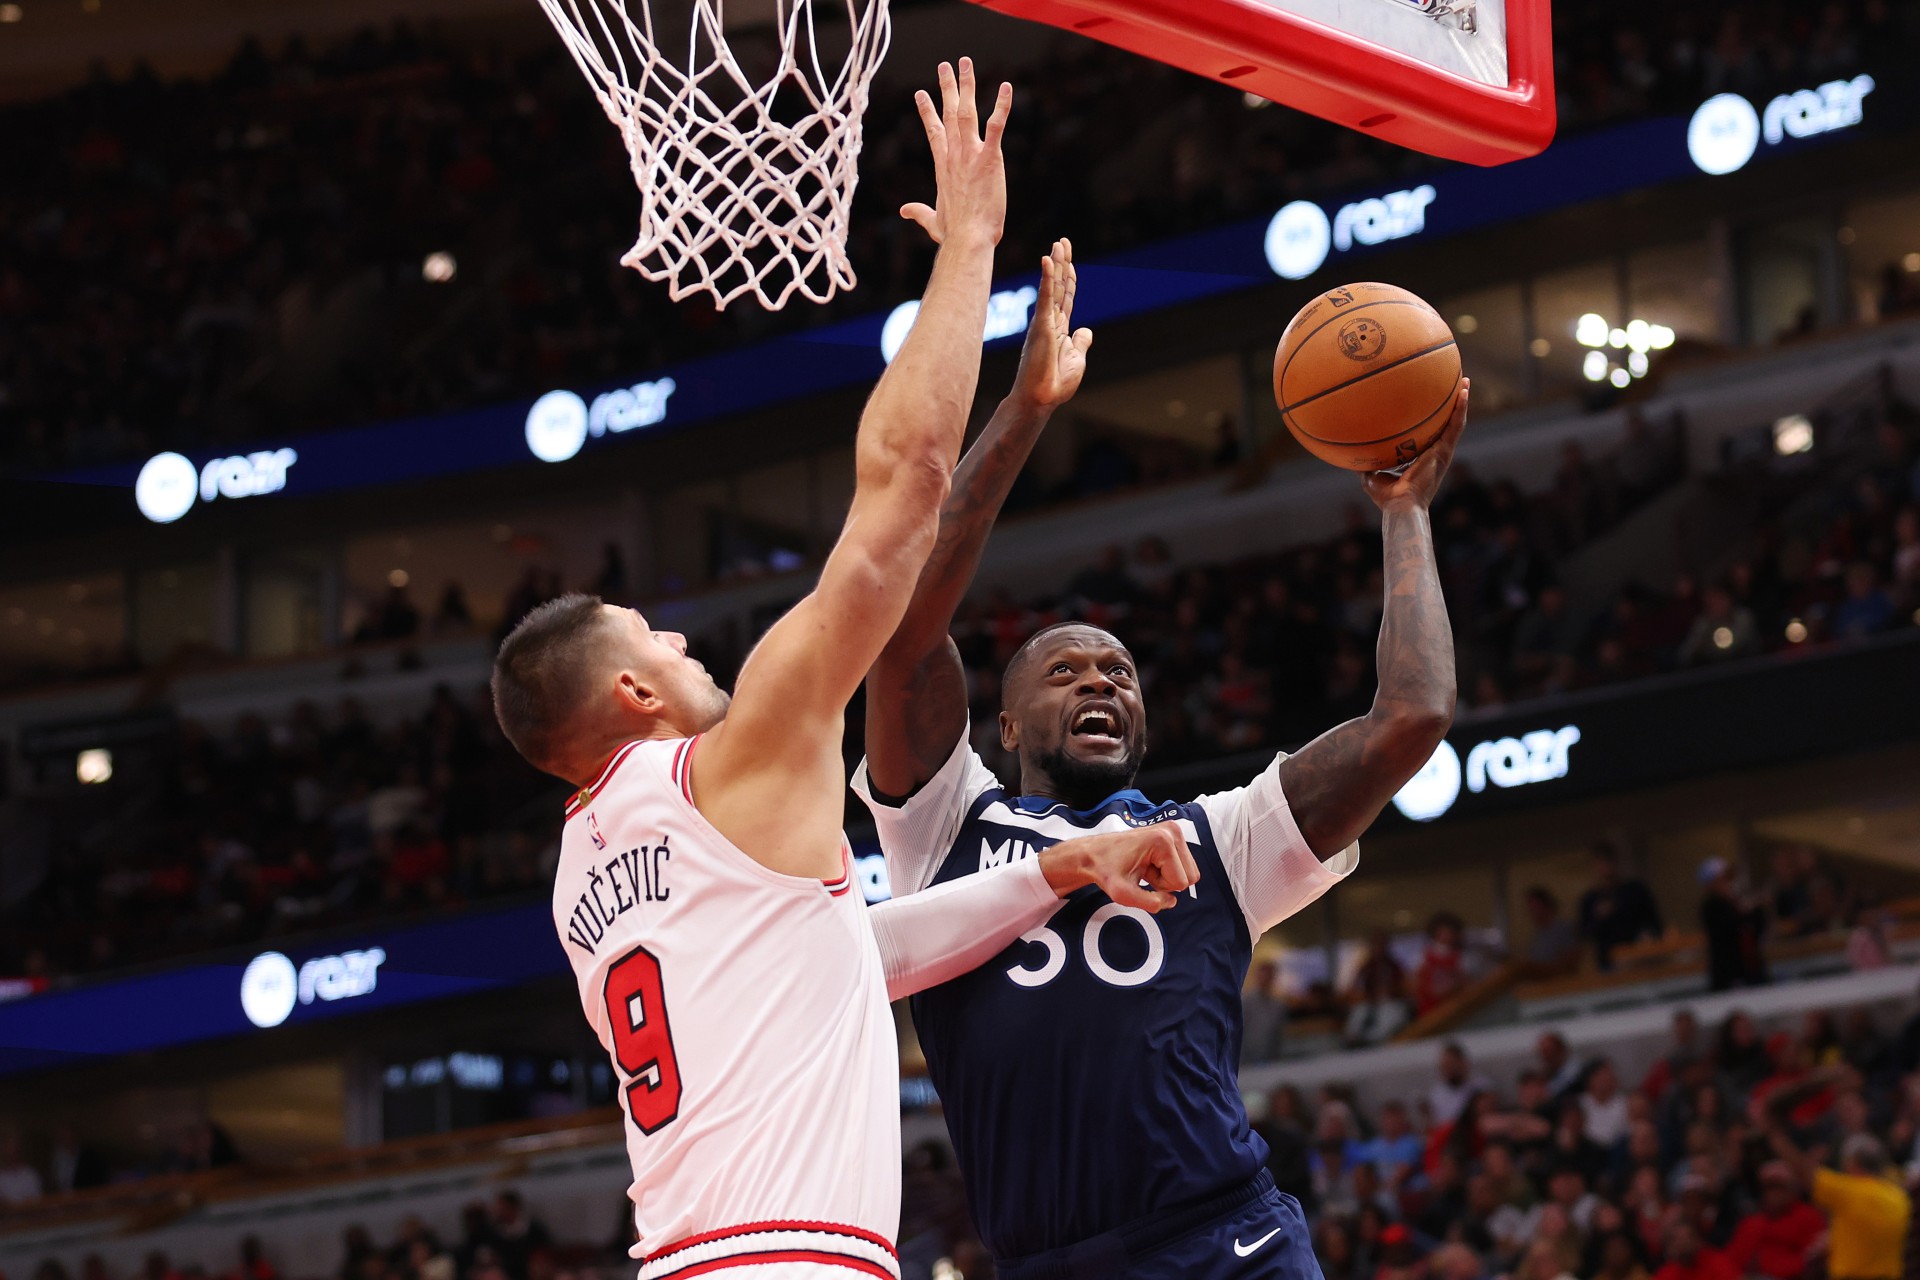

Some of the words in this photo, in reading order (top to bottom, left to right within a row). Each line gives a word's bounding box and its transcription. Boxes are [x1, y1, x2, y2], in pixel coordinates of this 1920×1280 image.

[1763, 74, 1875, 145] razr
[1333, 185, 1436, 251] razr
[589, 377, 676, 437] razr
[200, 447, 298, 503] razr
[1466, 725, 1581, 793] razr
[1130, 809, 1178, 827] sezzle
[568, 835, 671, 955] VUČEVIĆ
[298, 947, 386, 1005] razr
[603, 945, 683, 1137] 9
